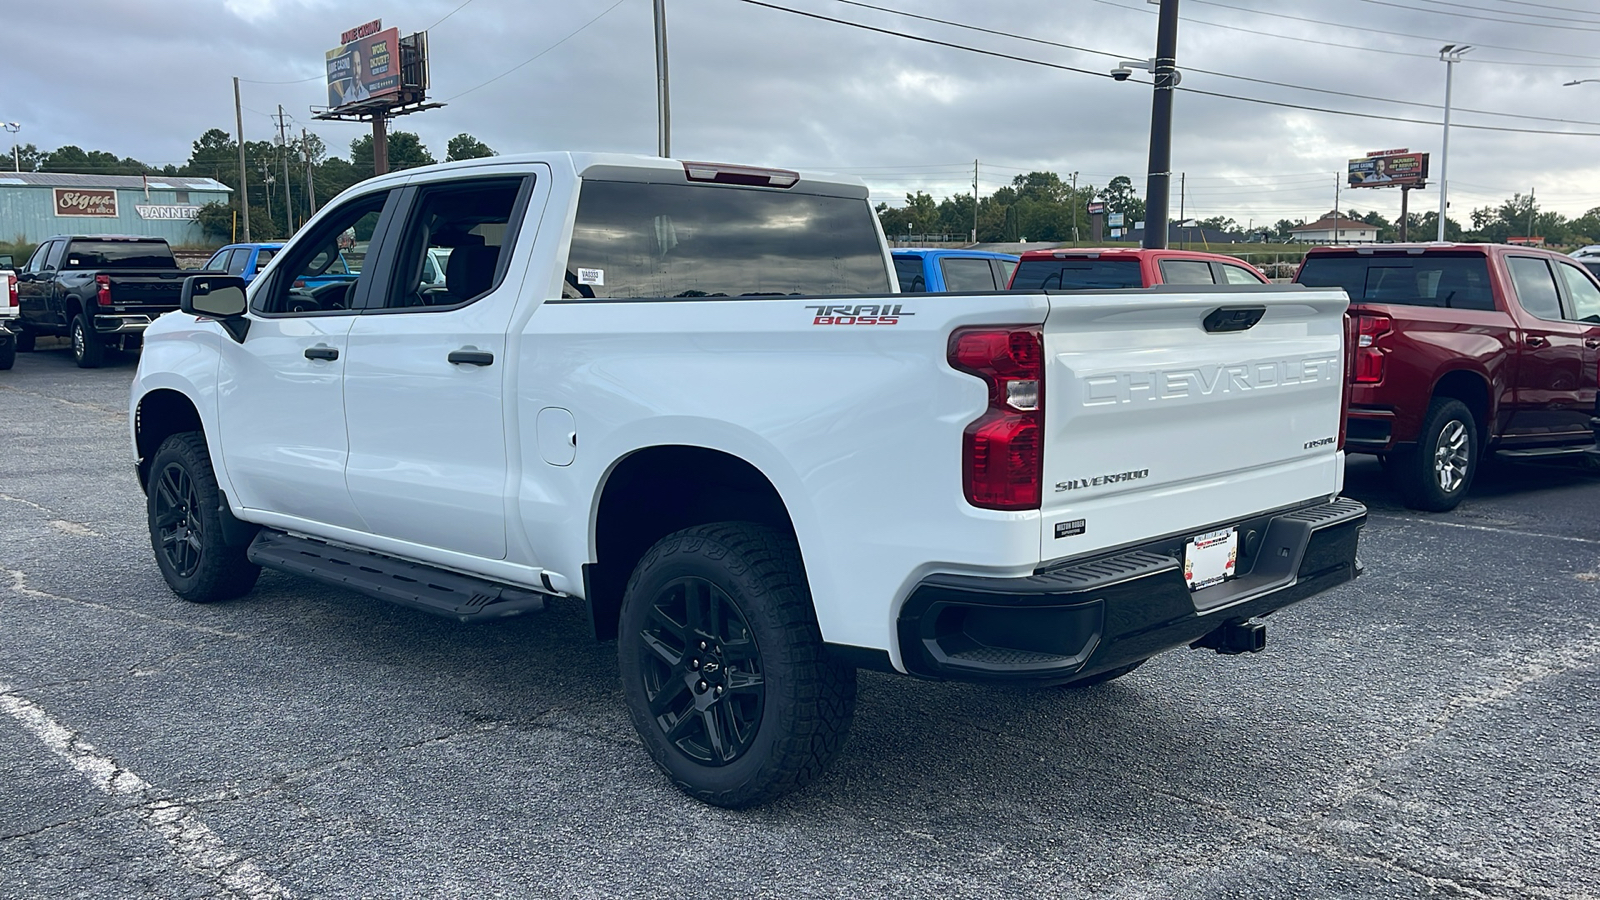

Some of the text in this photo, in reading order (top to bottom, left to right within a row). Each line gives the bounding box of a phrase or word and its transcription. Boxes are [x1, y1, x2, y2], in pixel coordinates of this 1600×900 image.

[60, 191, 110, 210] Signs
[804, 304, 916, 316] TRAIL
[812, 316, 900, 326] BOSS
[1083, 356, 1338, 407] CHEVROLET
[1054, 468, 1150, 493] SILVERADO
